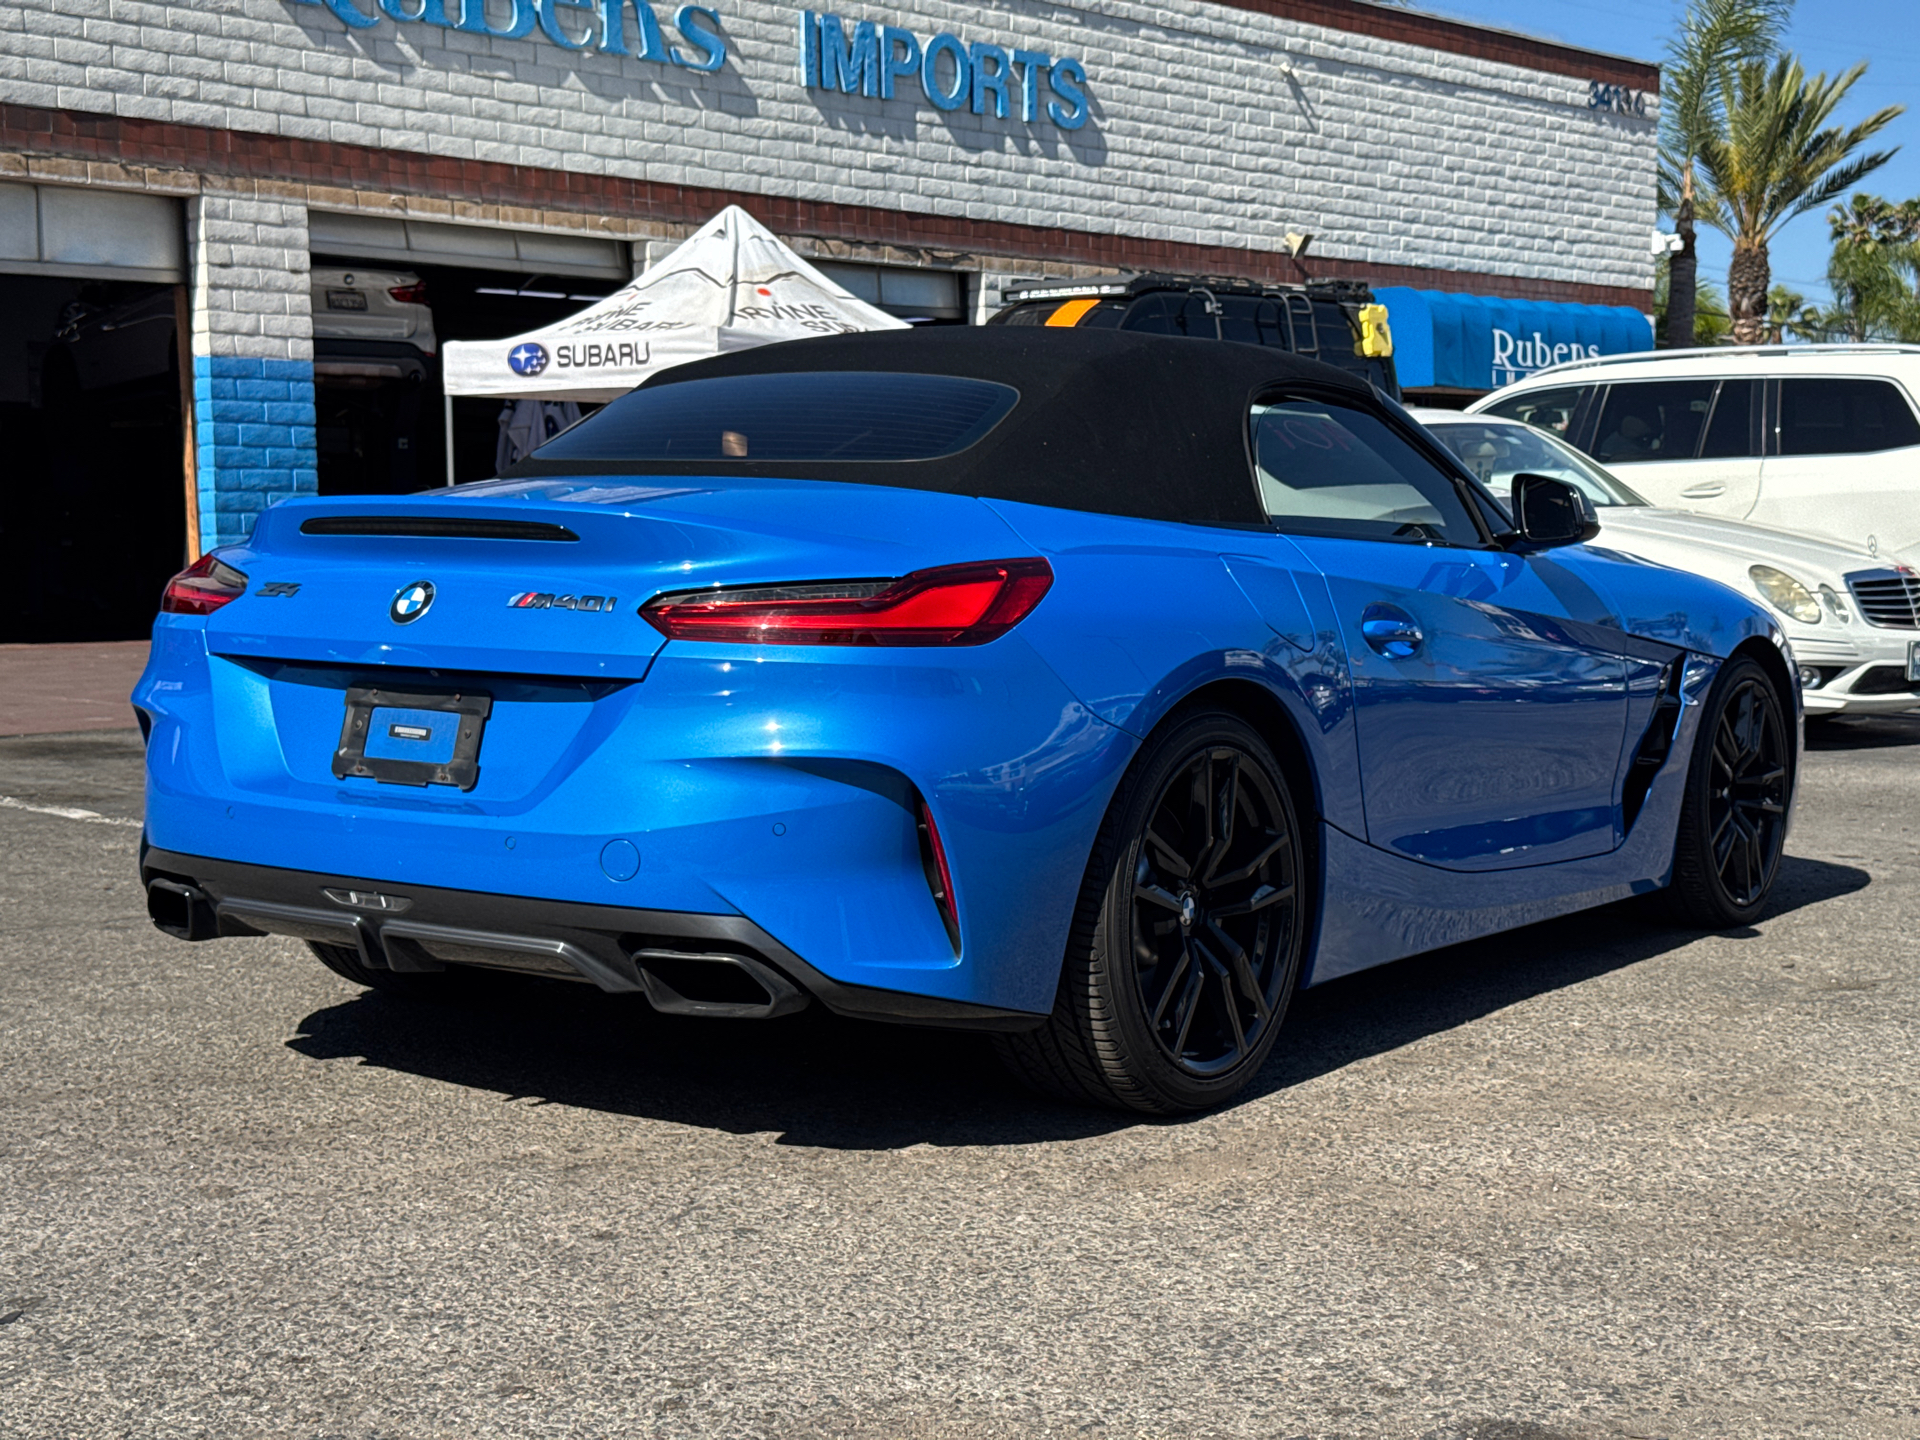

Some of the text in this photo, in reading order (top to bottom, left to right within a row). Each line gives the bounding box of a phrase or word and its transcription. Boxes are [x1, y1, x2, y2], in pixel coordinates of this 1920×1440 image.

[294, 0, 726, 71] ens
[803, 10, 1088, 130] IMPORTS
[556, 342, 652, 369] SUBARU
[1491, 328, 1600, 371] Rubens
[254, 582, 303, 598] Z4
[506, 591, 618, 614] M40i
